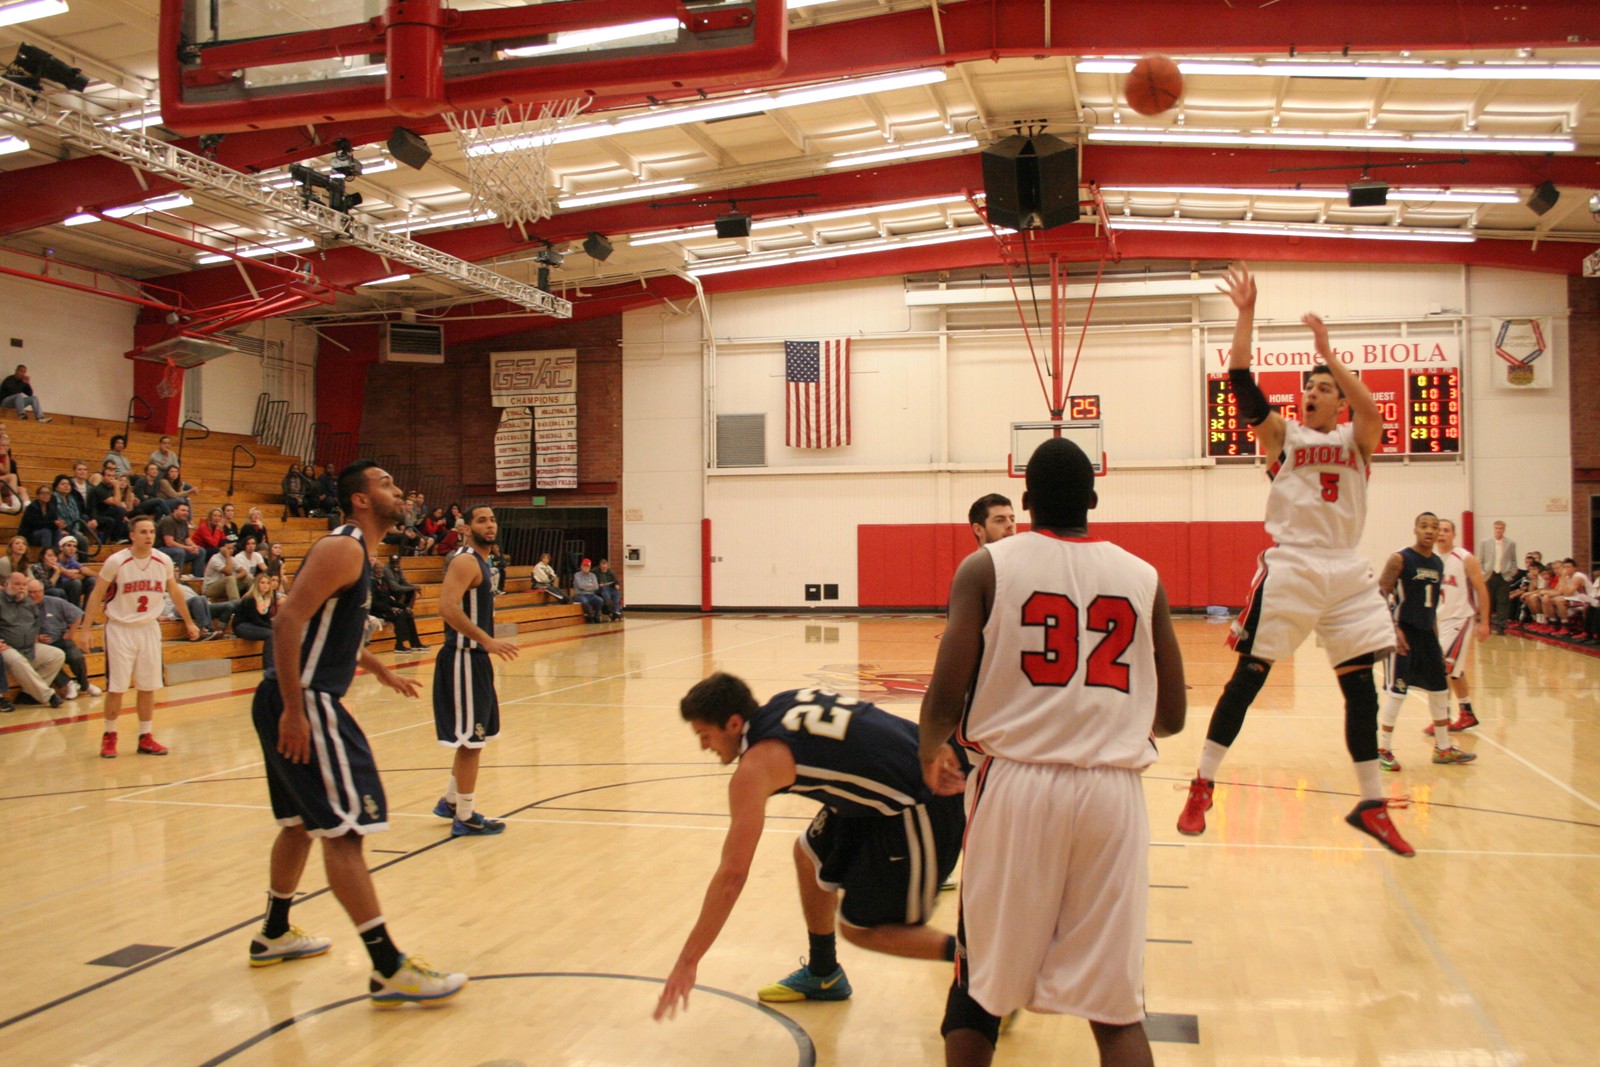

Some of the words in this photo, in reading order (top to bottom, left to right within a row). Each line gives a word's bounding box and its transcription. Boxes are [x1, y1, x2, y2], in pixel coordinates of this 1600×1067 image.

[1216, 347, 1325, 367] Wlcome
[1361, 343, 1448, 364] BIOLA
[492, 357, 575, 390] GSAC
[1220, 381, 1225, 390] 1
[1432, 376, 1439, 385] 1
[1448, 375, 1457, 386] 2
[1216, 393, 1225, 404] 2
[1269, 394, 1294, 403] HOME
[1372, 391, 1395, 401] UEST
[1429, 388, 1439, 399] 0
[1449, 388, 1457, 399] 3
[510, 396, 560, 405] CHAMPIONS
[1072, 398, 1098, 418] 25
[1216, 406, 1225, 417] 5
[1228, 406, 1236, 417] 0
[1414, 402, 1428, 412] 11
[1429, 401, 1439, 413] 0
[1448, 401, 1457, 412] 0
[1210, 418, 1225, 430] 32
[1228, 418, 1236, 430] 0
[1414, 415, 1428, 425] 14
[1429, 414, 1439, 425] 0
[1449, 414, 1457, 425] 0
[1210, 431, 1226, 443] 34
[1231, 432, 1237, 441] 1
[1246, 431, 1255, 442] 5
[1386, 429, 1397, 444] 5
[1410, 428, 1428, 439] 23
[1430, 427, 1439, 439] 0
[1445, 427, 1458, 438] 10
[1228, 444, 1237, 455] 2
[1430, 440, 1439, 452] 5
[1294, 445, 1361, 471] BIOLA
[1319, 472, 1340, 503] 5
[123, 580, 164, 594] BIOLA
[1424, 584, 1433, 607] 1
[136, 595, 149, 613] 2
[1020, 590, 1138, 695] 32
